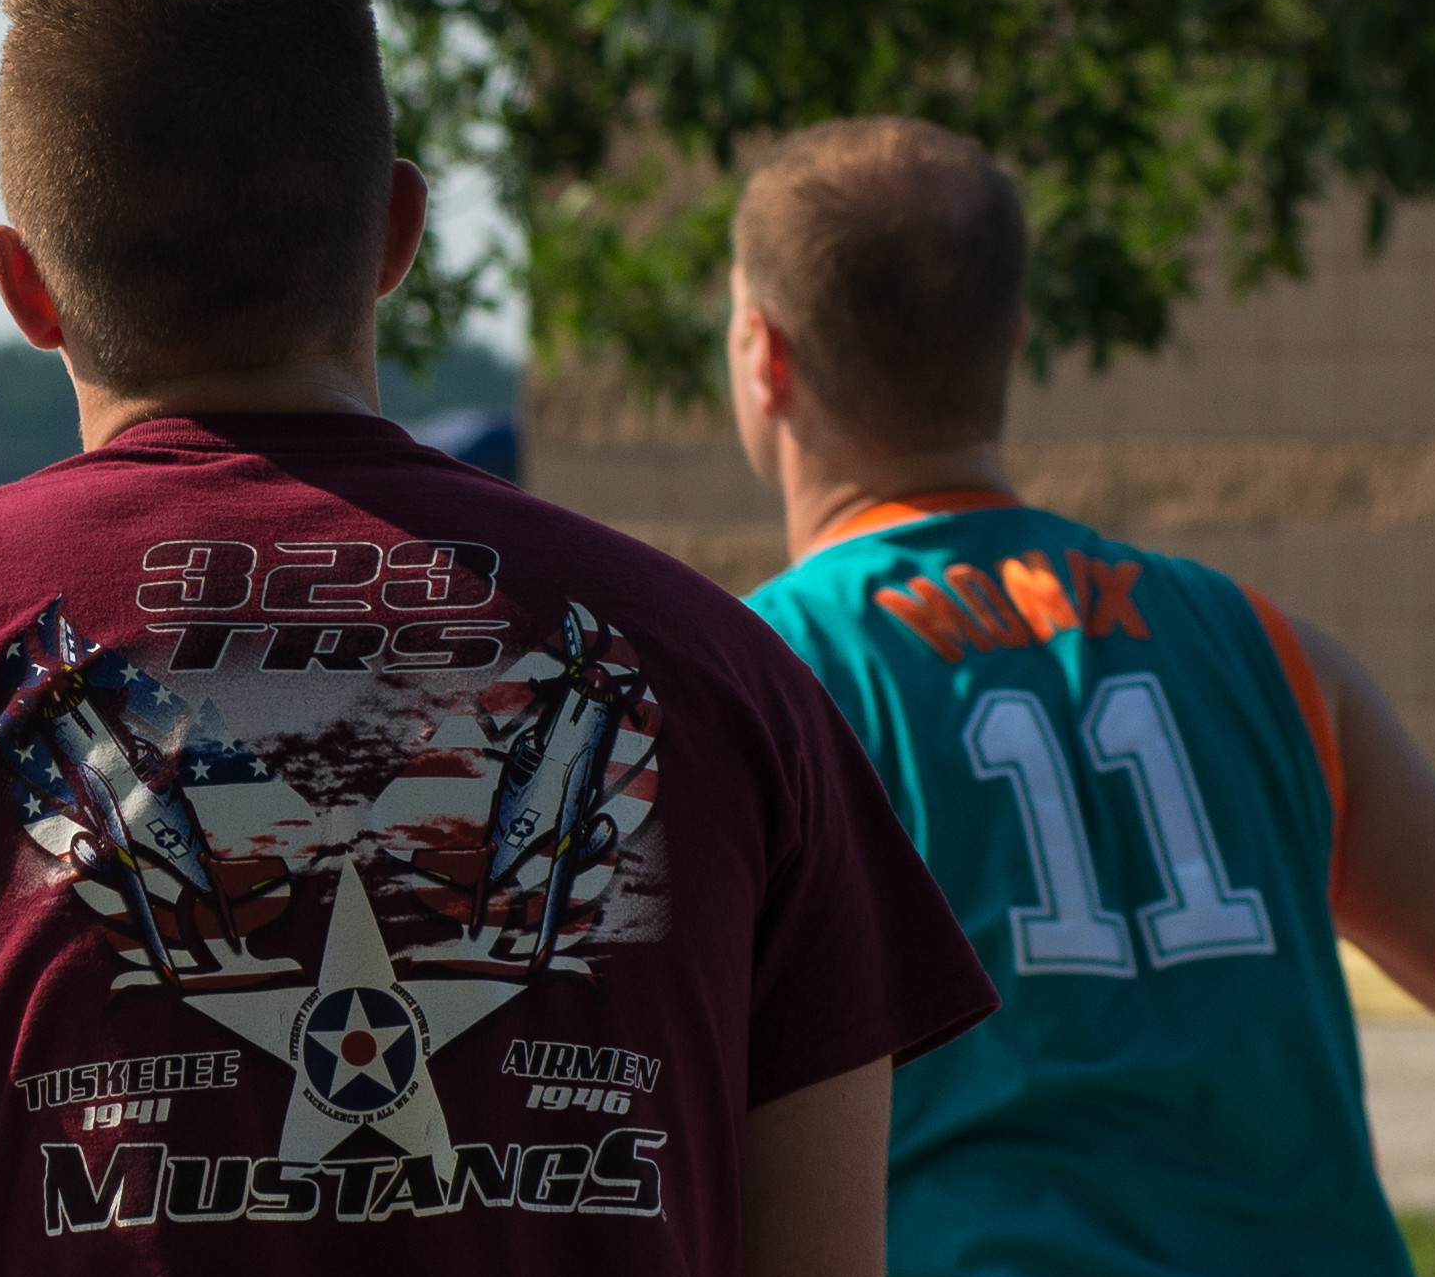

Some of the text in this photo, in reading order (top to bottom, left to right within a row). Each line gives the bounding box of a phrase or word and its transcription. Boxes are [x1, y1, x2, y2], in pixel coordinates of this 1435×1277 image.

[135, 539, 500, 613] 323
[145, 620, 511, 673] TRS
[961, 672, 1277, 979] 11
[390, 982, 416, 1007] SERVICE
[290, 988, 322, 1061] INTEGRITY FIRST
[15, 1050, 241, 1112] TUSKEGEE
[502, 1039, 661, 1093] AIRMEN
[82, 1098, 171, 1131] 1941
[302, 1080, 420, 1124] EXCELLENCE IN ALL WE DO
[526, 1084, 632, 1114] 1946
[40, 1127, 668, 1237] MUSTANGS
